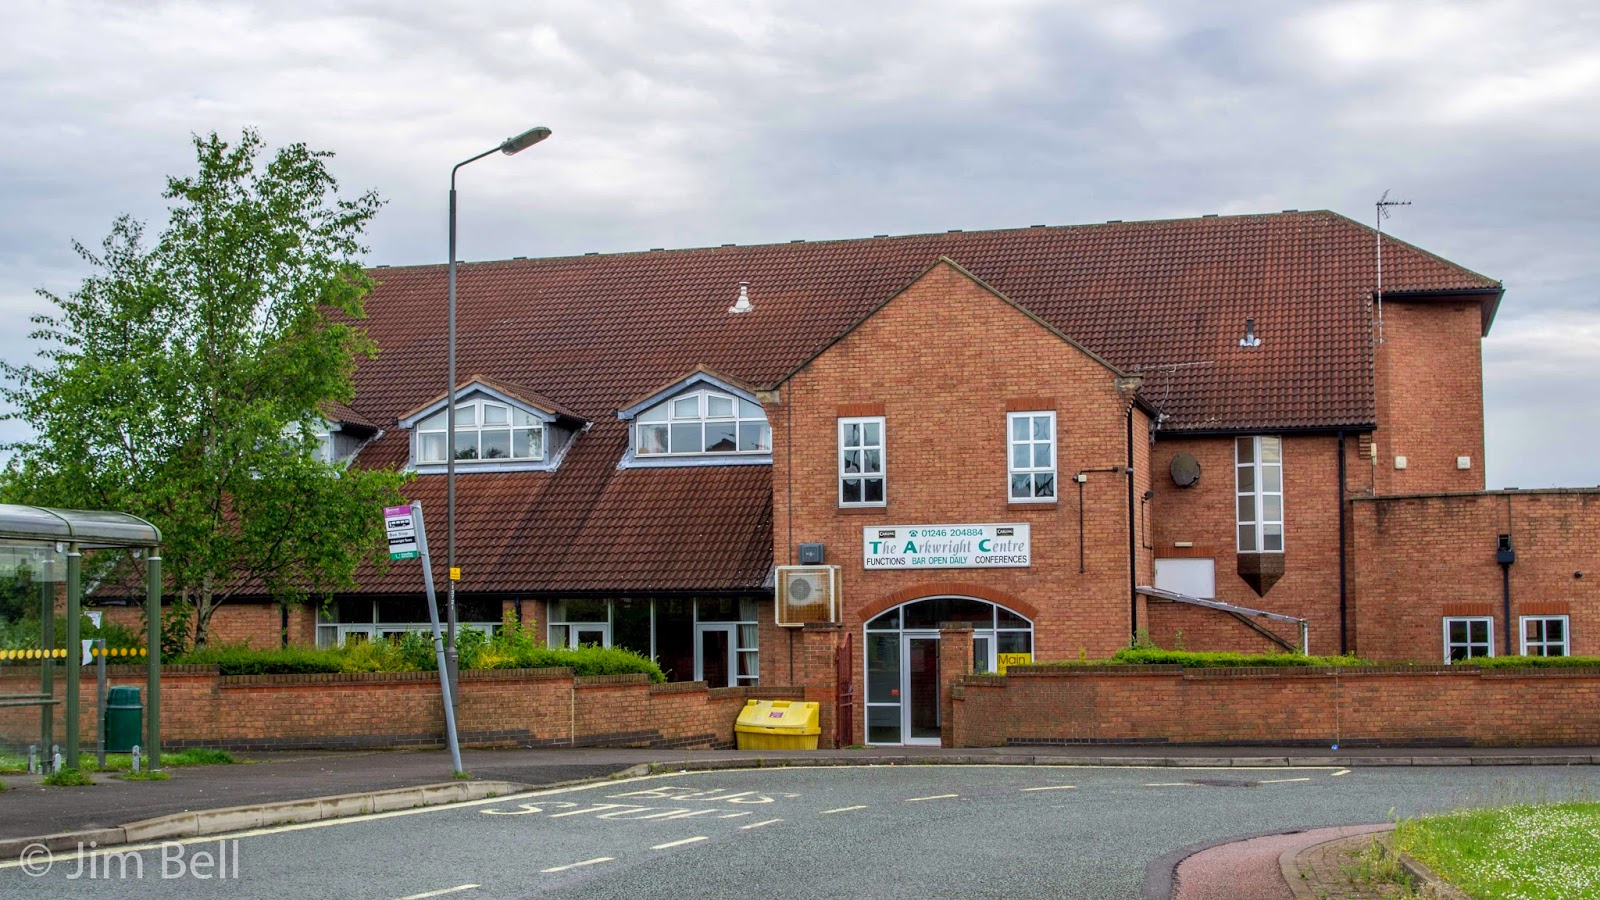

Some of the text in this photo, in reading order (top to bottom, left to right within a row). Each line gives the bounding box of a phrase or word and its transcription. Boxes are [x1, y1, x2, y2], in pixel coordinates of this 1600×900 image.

[921, 529, 983, 537] 01246 204884
[869, 538, 1025, 556] The Arkwright Centre
[866, 555, 1028, 566] FUNCTIONS BAR OPEN DAILY CONFERENCES
[998, 654, 1026, 665] Main
[478, 801, 753, 821] STOP
